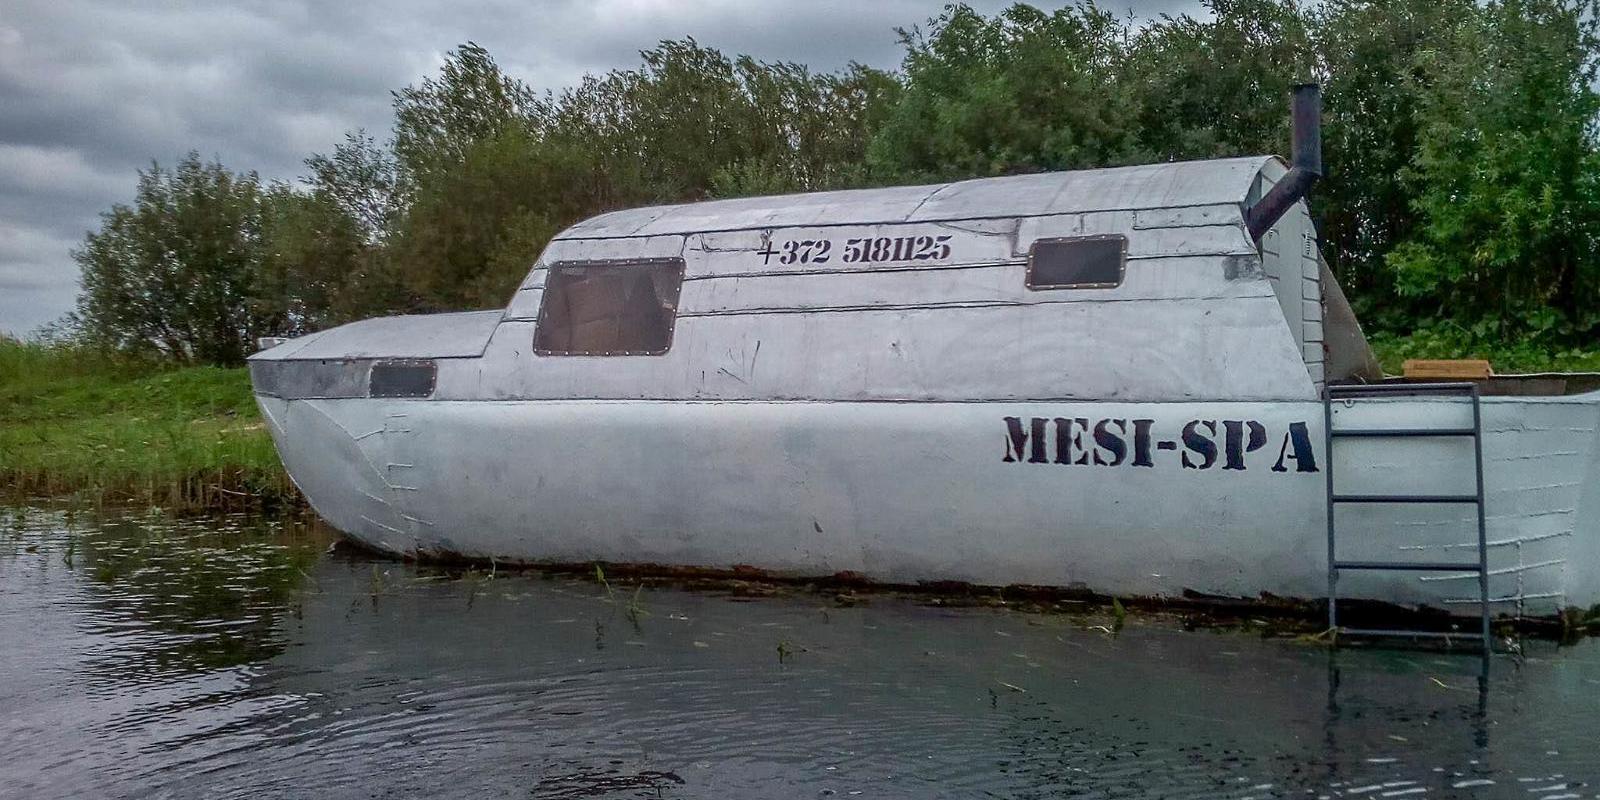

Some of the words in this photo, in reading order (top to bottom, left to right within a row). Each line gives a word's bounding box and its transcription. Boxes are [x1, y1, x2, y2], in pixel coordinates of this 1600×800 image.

[756, 239, 832, 265] +372
[842, 235, 953, 263] 5181125
[1002, 416, 1320, 473] MESI-SPA
